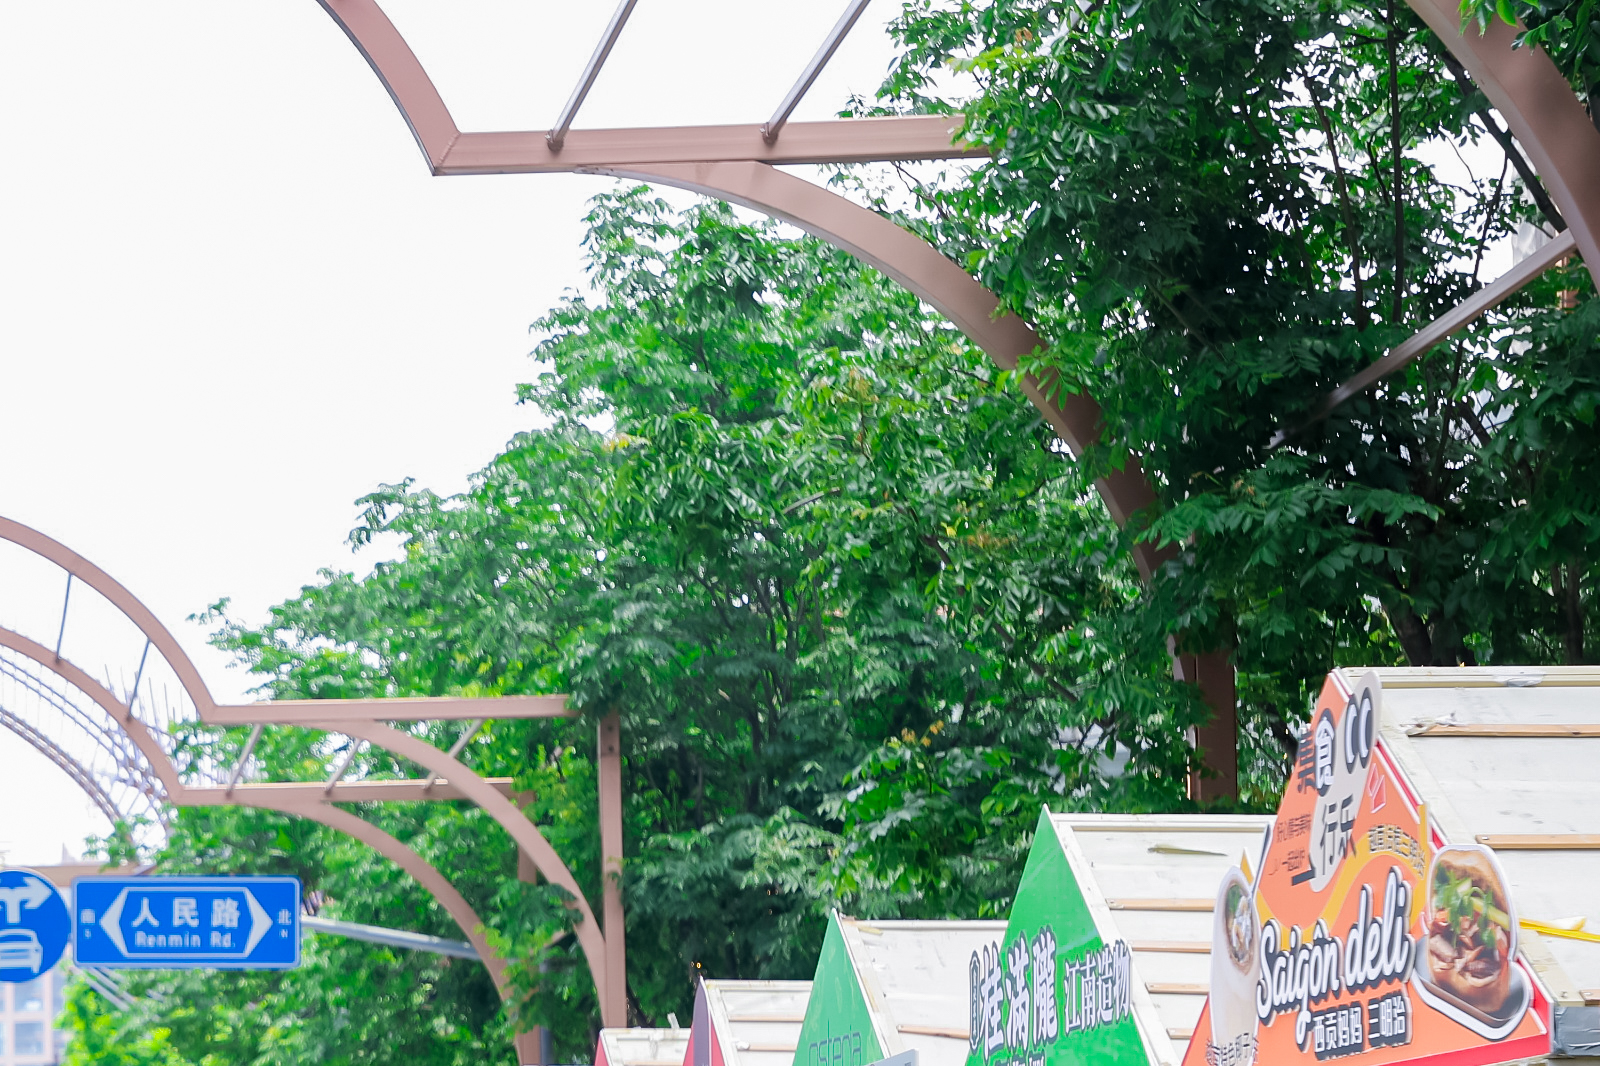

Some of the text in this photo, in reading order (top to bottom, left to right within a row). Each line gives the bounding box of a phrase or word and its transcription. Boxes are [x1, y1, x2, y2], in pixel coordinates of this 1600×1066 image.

[80, 908, 96, 925] 南
[132, 897, 240, 928] 人民路
[277, 909, 292, 926] 北
[1346, 869, 1409, 988] deli
[134, 931, 235, 948] Renmin Rd.
[1064, 941, 1131, 1033] 江南造物
[1313, 1004, 1363, 1053] 西贡妈妈
[1368, 996, 1406, 1042] 三明治
